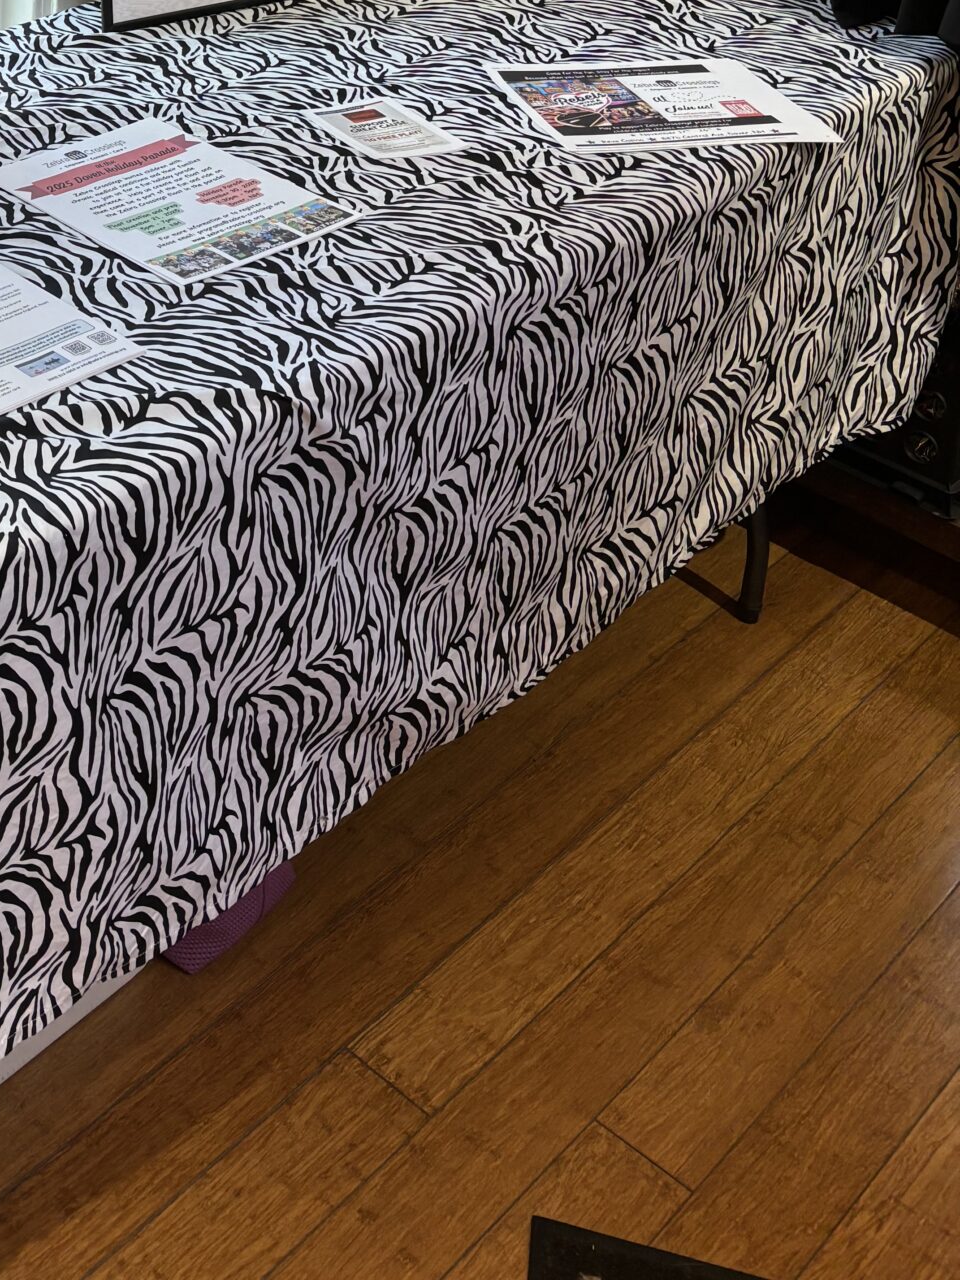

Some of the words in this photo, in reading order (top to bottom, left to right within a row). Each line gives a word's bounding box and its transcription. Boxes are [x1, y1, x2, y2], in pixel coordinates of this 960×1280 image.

[553, 93, 606, 106] Rebels
[665, 105, 695, 113] Join
[350, 120, 389, 129] SUPPORT
[350, 125, 379, 133] GREAT
[380, 121, 408, 129] CAUSE
[42, 158, 70, 168] Zebra
[84, 140, 127, 156] Crossings
[46, 181, 73, 192] 2025
[73, 171, 104, 184] Dover
[105, 159, 142, 174] Holiday
[142, 147, 179, 162] Parade
